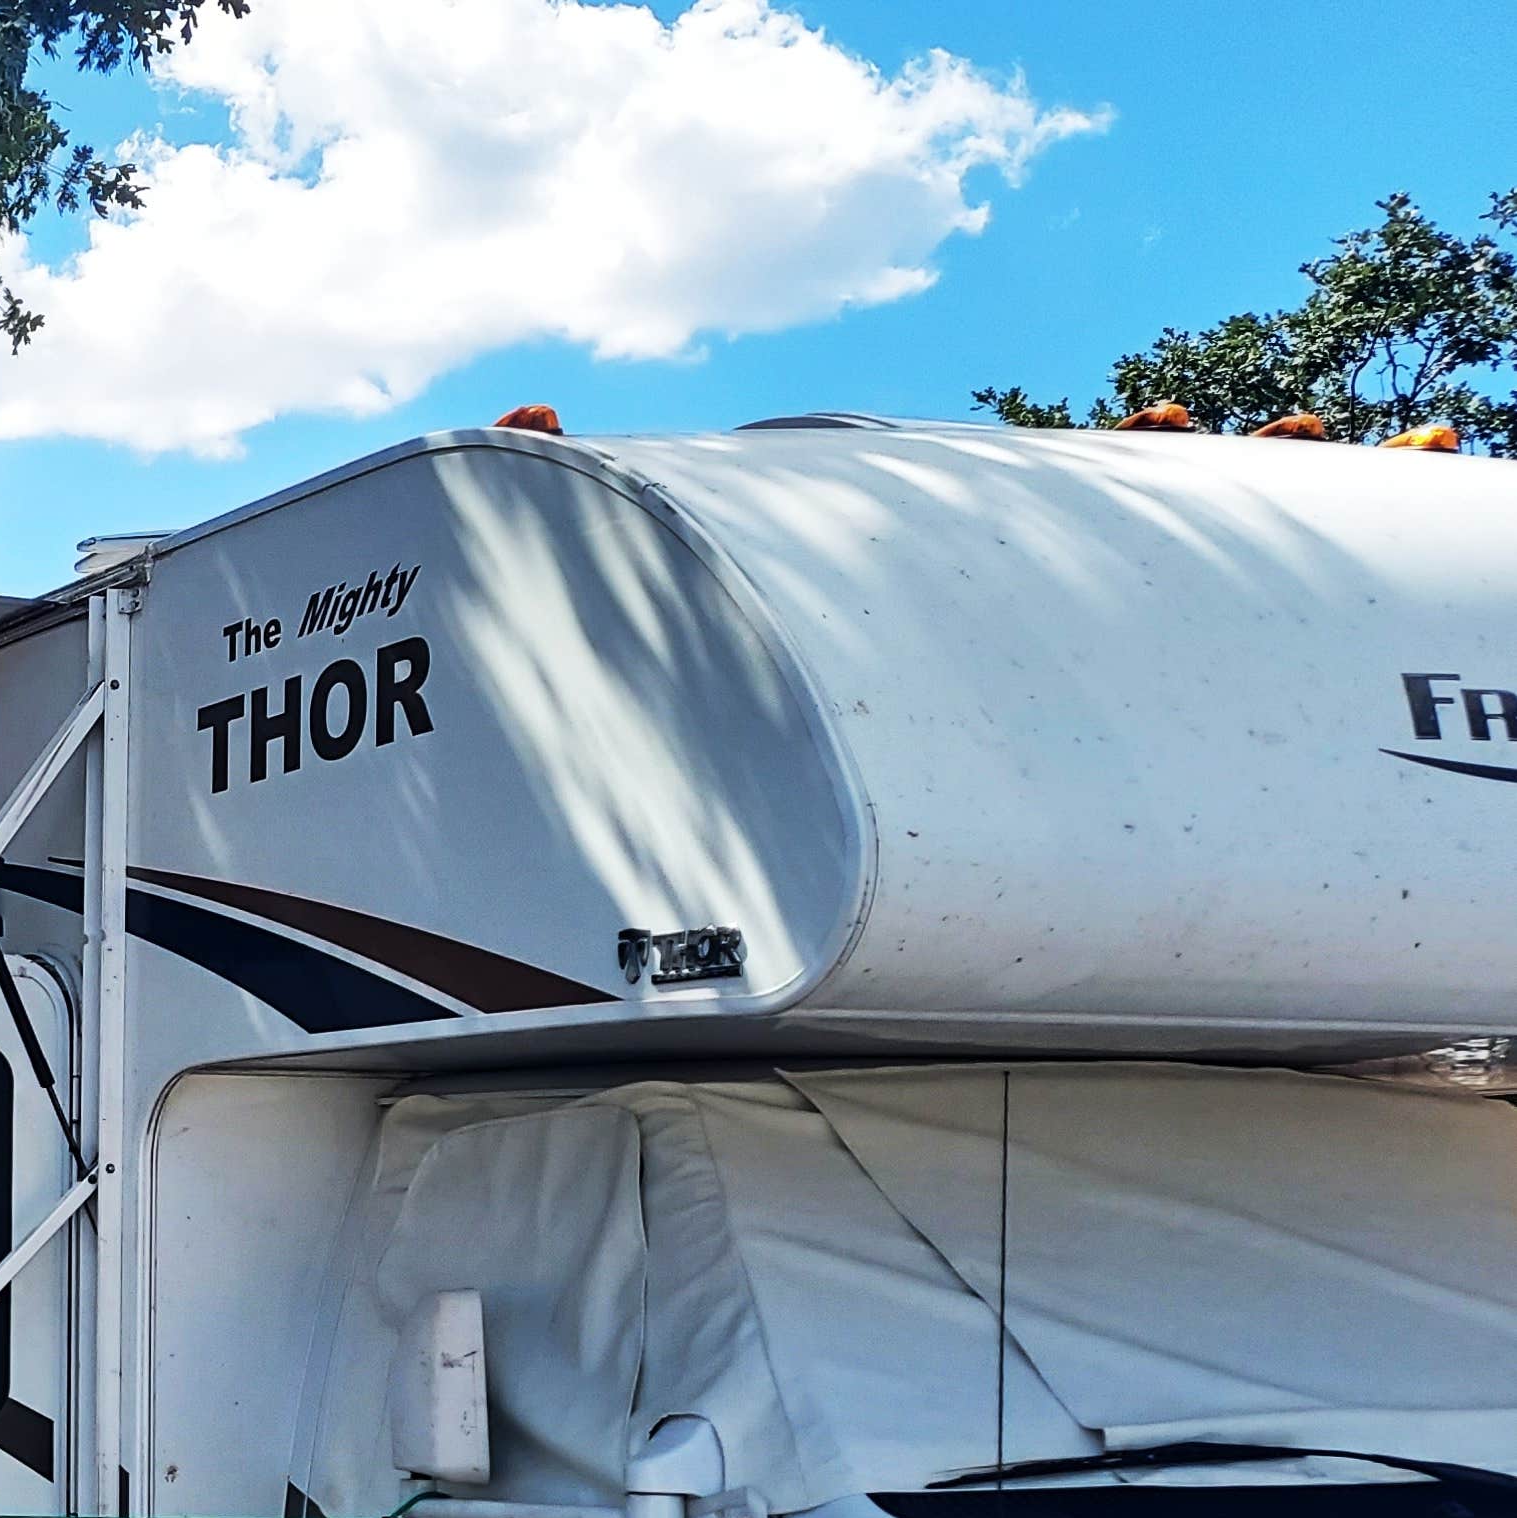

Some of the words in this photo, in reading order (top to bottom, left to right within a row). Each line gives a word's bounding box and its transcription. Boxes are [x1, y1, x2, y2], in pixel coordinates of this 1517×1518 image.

[222, 617, 282, 663] The
[297, 561, 422, 638] Mighty
[197, 635, 435, 794] THOR
